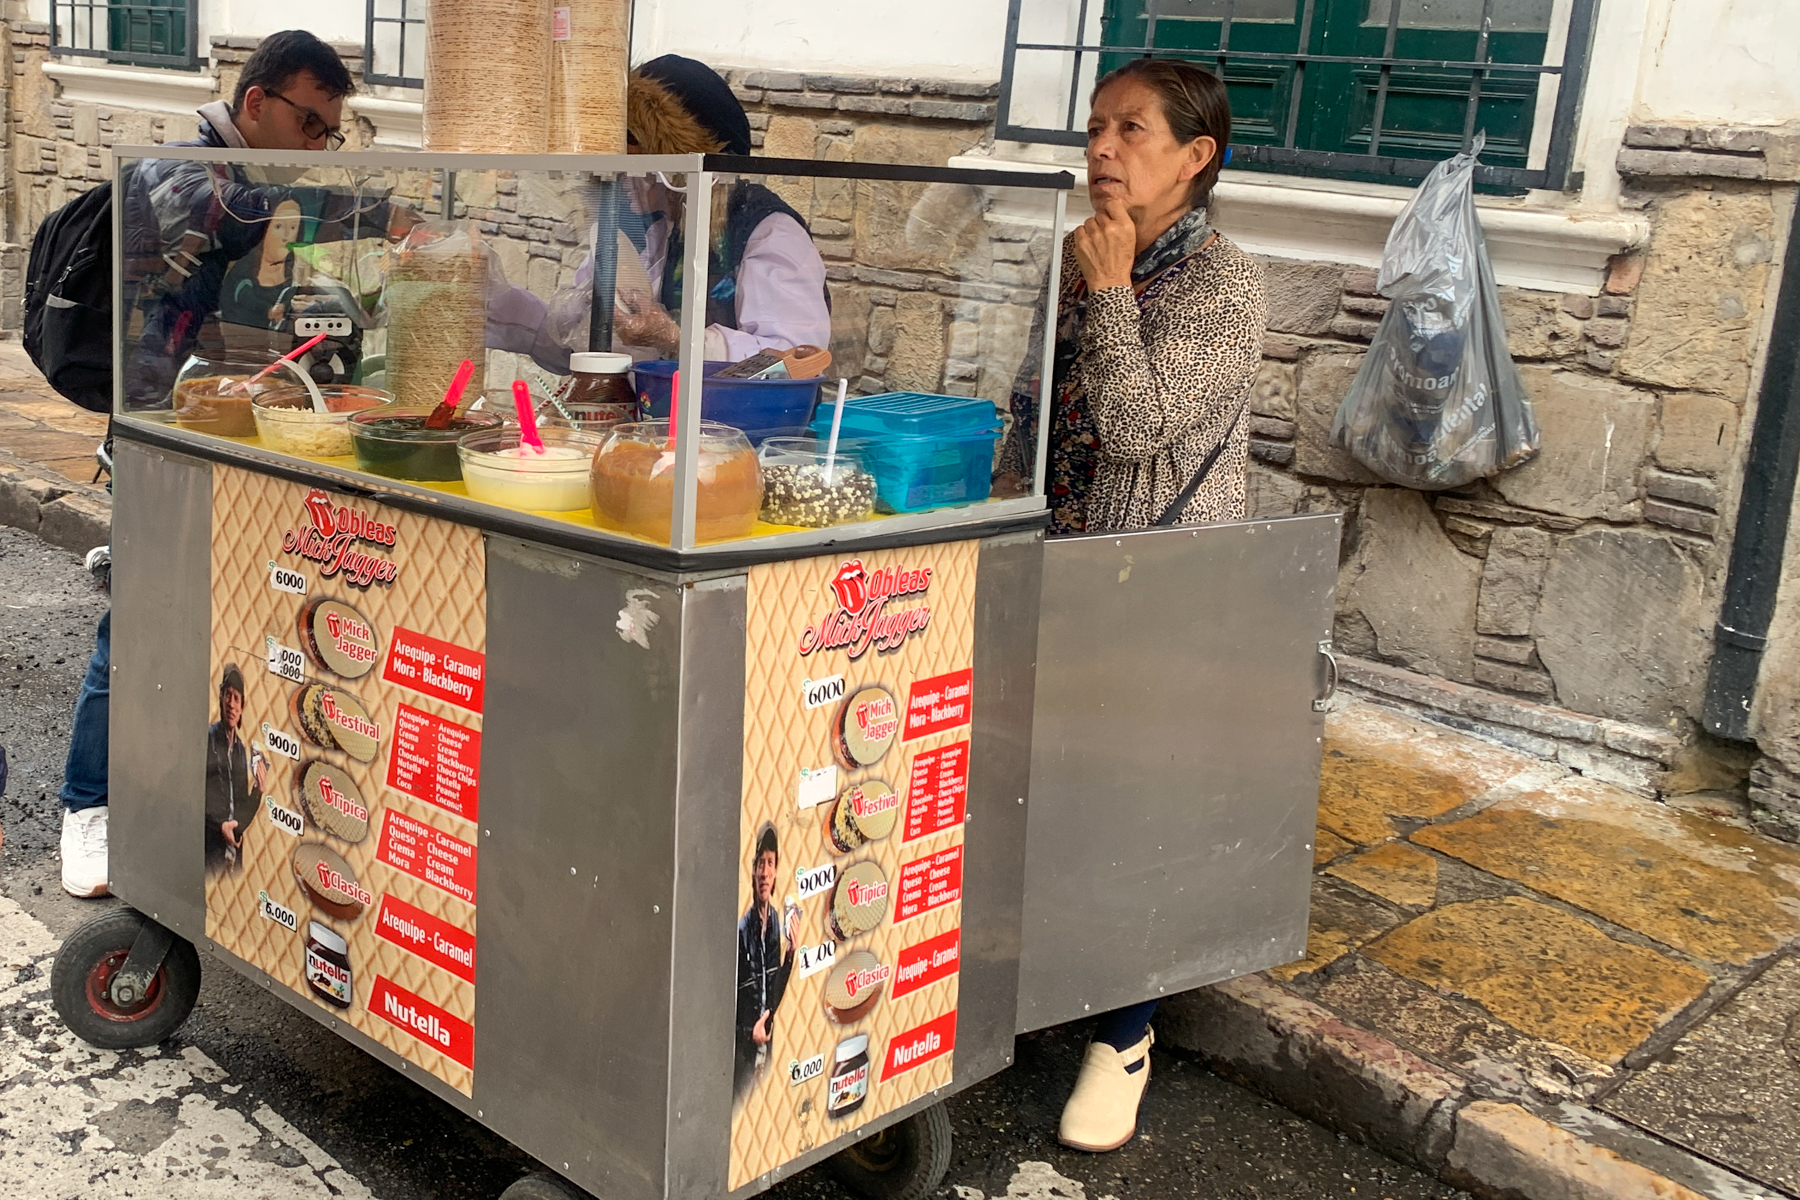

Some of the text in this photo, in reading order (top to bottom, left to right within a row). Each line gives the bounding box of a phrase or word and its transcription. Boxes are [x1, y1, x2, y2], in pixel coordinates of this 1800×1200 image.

[337, 507, 396, 545] Obleas
[282, 524, 397, 586] Mick Jagger
[276, 570, 304, 590] 6000
[868, 565, 931, 600] Obleas
[343, 618, 370, 640] Mick
[799, 596, 930, 657] Mick Jagger
[337, 637, 377, 661] Jagger
[395, 639, 435, 666] Arequipe
[443, 654, 481, 681] Caramel
[393, 657, 415, 678] Mora
[423, 667, 473, 702] Blackberry
[809, 678, 845, 705] 6000
[911, 689, 940, 710] Arequipe
[945, 680, 970, 700] Caramel
[336, 709, 380, 740] Festival
[870, 699, 892, 719] Mick
[910, 713, 926, 729] Mora
[931, 703, 964, 723] Blackberry
[399, 708, 430, 726] Arequipe
[439, 723, 470, 742] Arequipe
[399, 718, 419, 732] Queso
[438, 733, 462, 749] Cheese
[865, 720, 897, 741] Jagger
[269, 733, 297, 756] 9000
[399, 728, 419, 743] Crema
[438, 743, 459, 758] Cream
[399, 738, 414, 751] Mora
[437, 753, 473, 776] Blackberry
[398, 748, 429, 767] Chocolate
[437, 763, 456, 778] Choco
[457, 772, 476, 787] Chips
[398, 757, 421, 774] Nutella
[436, 773, 461, 791] Nutella
[397, 767, 413, 781] Maní
[436, 783, 460, 800] Peanut
[397, 777, 412, 790] Coco
[436, 794, 462, 812] Coconut
[332, 792, 367, 820] Tipica
[863, 790, 899, 816] Festival
[389, 812, 429, 838] Arequipe
[436, 832, 471, 858] Caramel
[389, 825, 416, 845] Queso
[427, 842, 459, 865] Cheese
[389, 838, 415, 859] Crema
[427, 855, 454, 877] Cream
[903, 860, 931, 877] Arequipe
[936, 847, 959, 865] Caramel
[331, 873, 371, 905] Clasica
[388, 851, 410, 869] Mora
[426, 868, 473, 901] Blackberry
[800, 864, 837, 895] 9000
[903, 876, 922, 891] Queso
[929, 866, 950, 880] Cheese
[903, 889, 921, 903] Crema
[929, 880, 947, 893] Cream
[859, 883, 887, 905] Tipica
[902, 904, 918, 917] Mora
[928, 888, 959, 907] Blackberry
[266, 902, 295, 927] 6.000
[383, 907, 425, 944] Arequipe
[434, 932, 473, 968] Caramel
[309, 953, 348, 984] nutella
[857, 964, 890, 989] Clasica
[897, 956, 927, 983] Arequipe
[933, 941, 958, 968] Caramel
[385, 991, 450, 1047] Nutella
[893, 1031, 941, 1068] Nutella
[792, 1058, 822, 1081] 6.000
[831, 1067, 865, 1094] nutella
